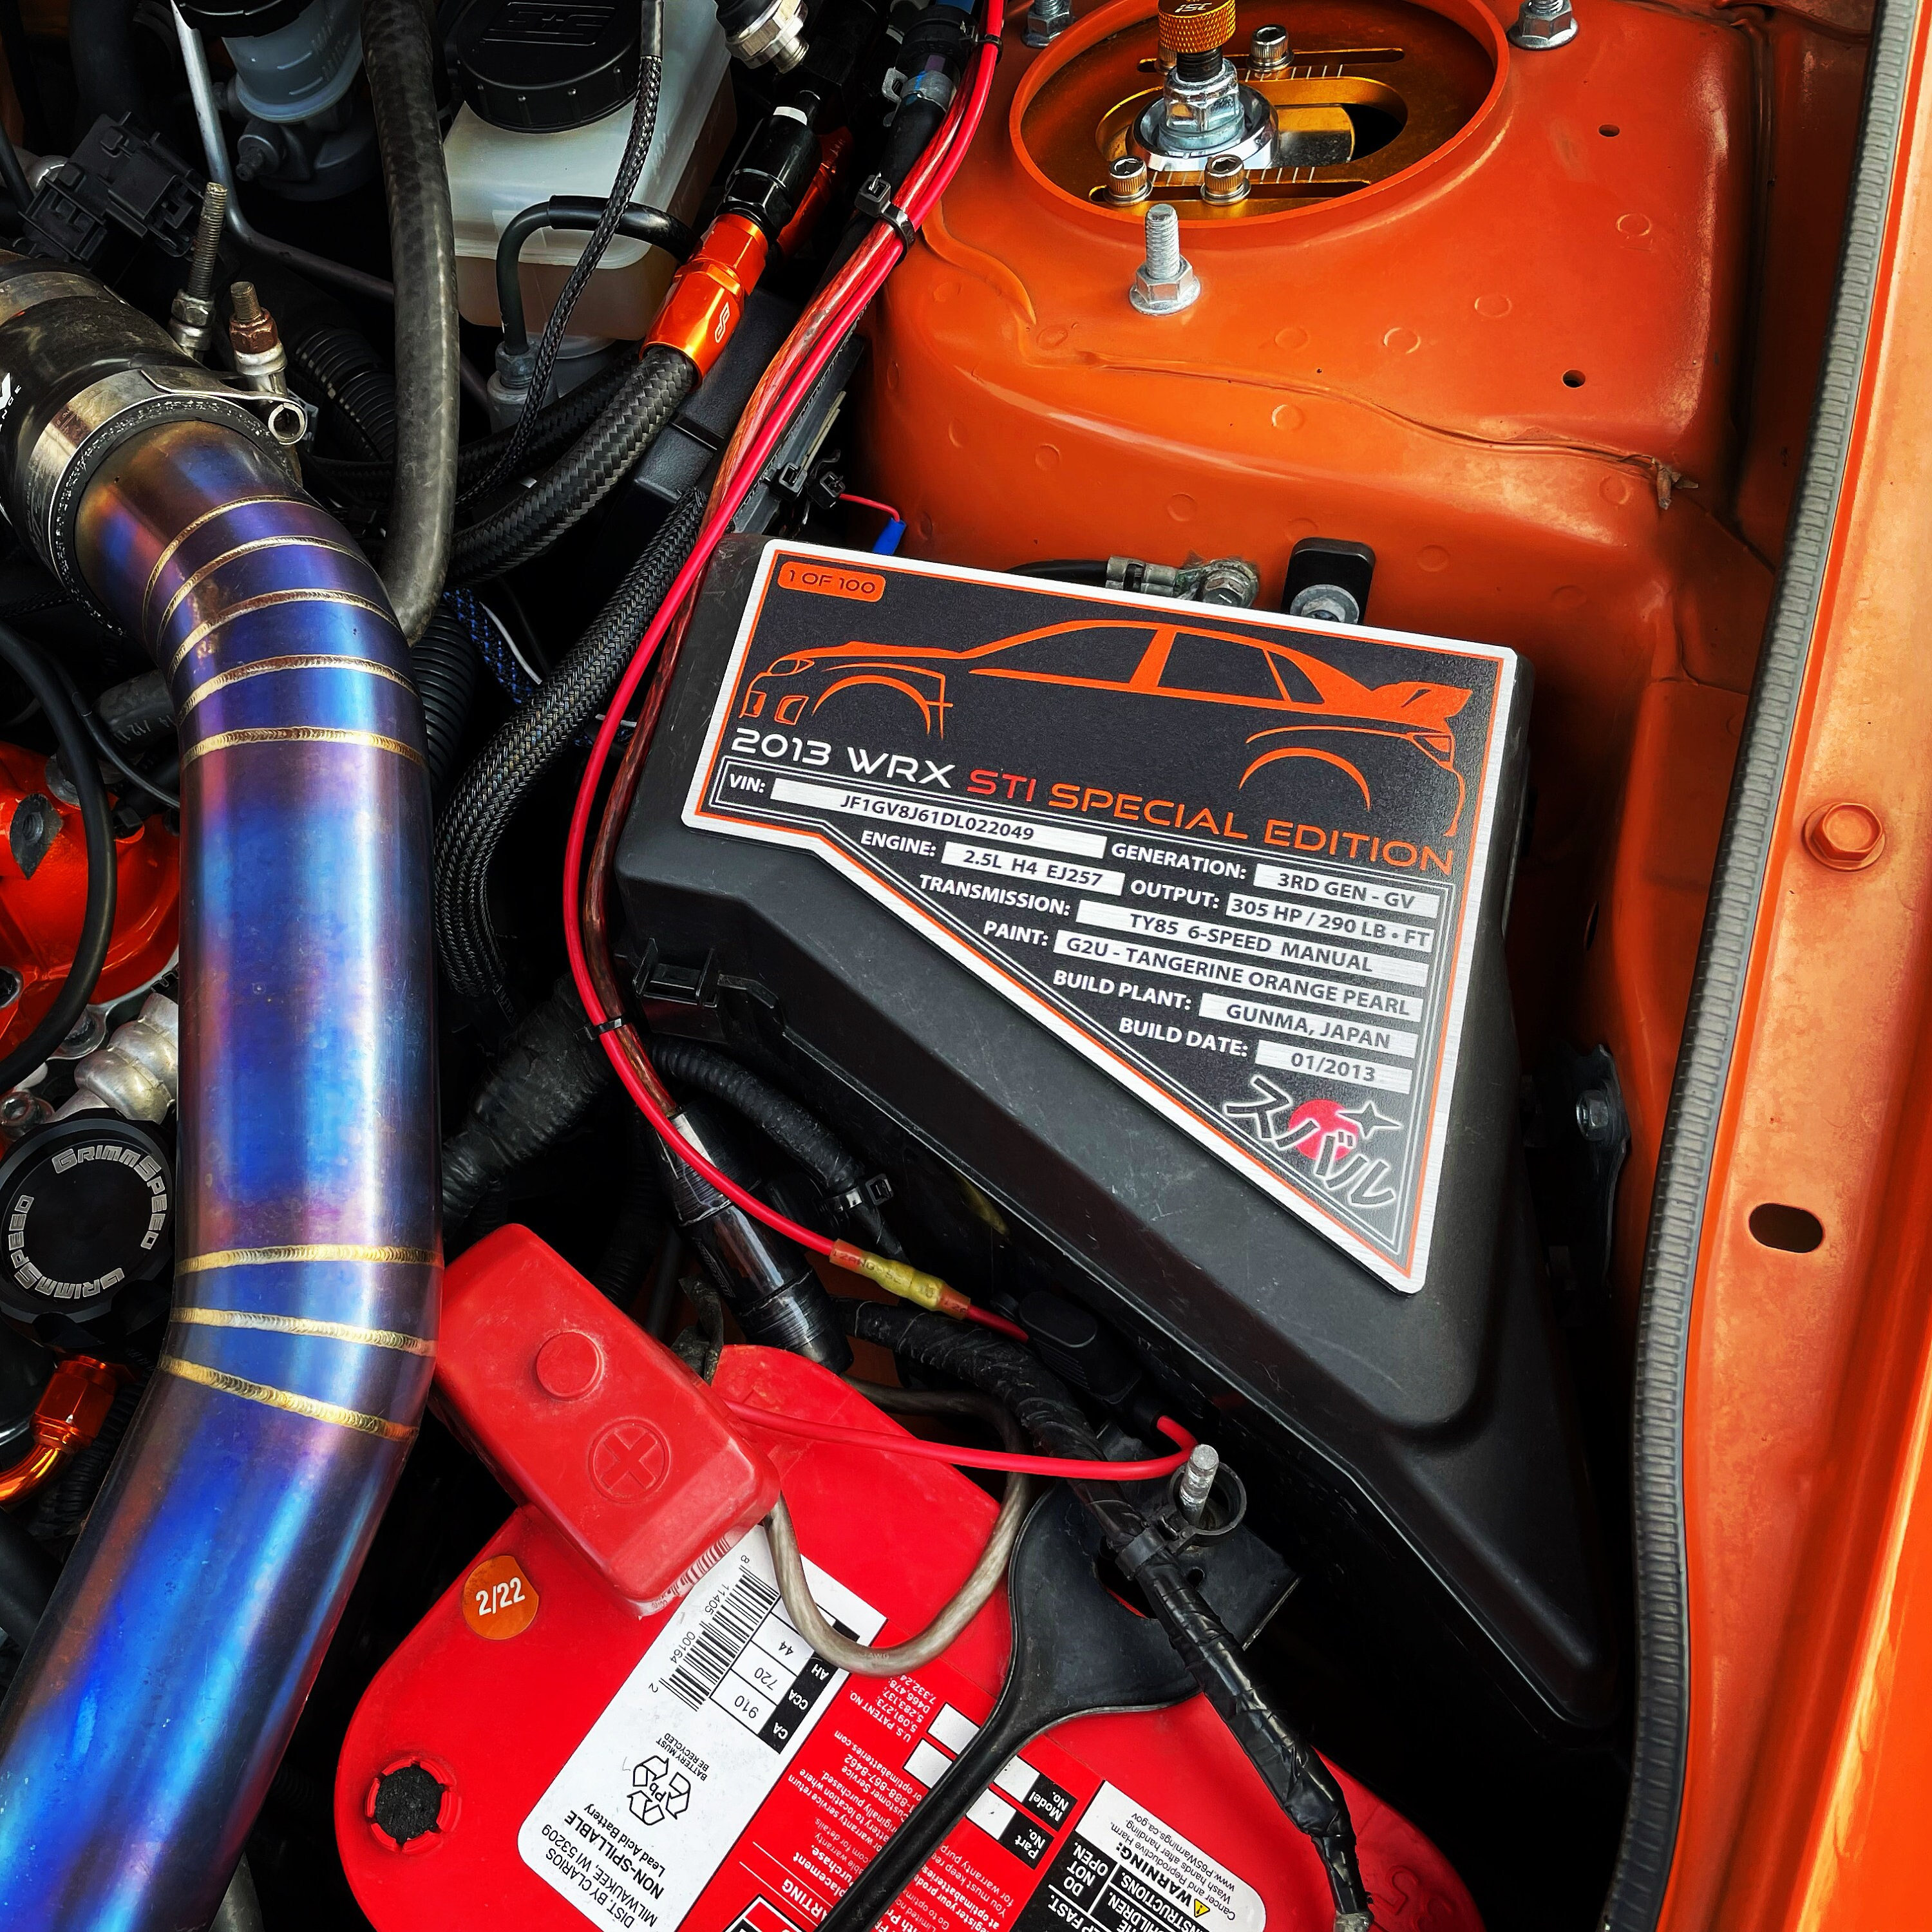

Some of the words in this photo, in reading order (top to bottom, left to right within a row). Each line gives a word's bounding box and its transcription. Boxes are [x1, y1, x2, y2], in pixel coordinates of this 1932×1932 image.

[790, 570, 795, 581] 1
[802, 573, 832, 586] OF
[840, 578, 875, 593] 100
[730, 773, 765, 793] VIN:
[840, 795, 1034, 840] JF1GV8J61DL022049
[732, 728, 831, 765] 2013
[848, 747, 955, 788] WRX
[967, 770, 1036, 801] STI
[1048, 783, 1248, 839] SPECIAL
[1264, 819, 1455, 875] EDITION
[861, 830, 936, 857] ENGINE:
[963, 850, 1001, 868] 2.5L
[1011, 858, 1037, 875] H4
[1046, 865, 1103, 886] EJ257
[1112, 843, 1246, 879] GENERATION:
[1278, 873, 1319, 891] 3RD
[1324, 882, 1367, 901] GEN
[1385, 893, 1416, 909] GV
[916, 875, 1070, 916] TRANSMISSION:
[1130, 914, 1179, 934] TY85
[1188, 926, 1271, 951] 6-SPEED
[1280, 942, 1372, 972] MANUAL
[1131, 880, 1219, 909] OUTPUT:
[1231, 899, 1269, 916] 305
[1274, 905, 1302, 922] HP
[1318, 914, 1356, 933] 290
[1361, 922, 1386, 938] LB
[1404, 929, 1430, 946] FT
[983, 920, 1048, 946] PAINT:
[1067, 938, 1108, 956] G2U
[1126, 948, 1244, 983] TANGERINE
[1249, 972, 1338, 1001] ORANGE
[1343, 989, 1409, 1016] PEARL
[1053, 970, 1115, 994] BUILD
[1118, 983, 1191, 1010] PLANT:
[1223, 1005, 1314, 1038] GUNMA,
[1320, 1023, 1390, 1048] JAPAN
[1119, 1018, 1182, 1043] BUILD
[1186, 1030, 1248, 1057] DATE:
[1291, 1053, 1375, 1081] 01/2013
[52, 1145, 167, 1250] GRIMMSPEED
[8, 1195, 125, 1299] GRIMMSPEED
[741, 1555, 750, 1564] 8
[476, 1577, 526, 1616] 2/22
[705, 1584, 729, 1615] 11405
[670, 1632, 696, 1663] 00164
[779, 1642, 793, 1655] 44
[754, 1668, 777, 1690] 720
[811, 1664, 829, 1680] AH
[649, 1683, 658, 1692] 2
[789, 1689, 808, 1710] CCA
[847, 1688, 864, 1705] NO.
[900, 1671, 936, 1704] 7,332,24
[735, 1696, 759, 1718] 910
[862, 1703, 895, 1730] PATENT
[773, 1723, 788, 1739] CA
[896, 1725, 911, 1743] U.S.
[656, 1738, 677, 1756] MUST
[665, 1733, 699, 1763] RECYCLED
[675, 1754, 707, 1781] BATTERY
[697, 1760, 709, 1772] BE
[835, 1730, 913, 1794] optimabatteries.com
[644, 1779, 668, 1803] Pb
[788, 1775, 812, 1796] return
[800, 1769, 824, 1791] where
[821, 1770, 866, 1807] purchased.
[842, 1766, 871, 1793] Service
[844, 1754, 914, 1813] 1-888-867-8462
[811, 1794, 839, 1817] service
[824, 1788, 856, 1817] location
[870, 1789, 908, 1823] Customer
[913, 1792, 922, 1801] or
[1028, 1792, 1063, 1821] Model
[1053, 1792, 1068, 1811] No.
[584, 1804, 620, 1839] Battery
[813, 1816, 840, 1841] details.
[838, 1814, 873, 1845] warranty
[856, 1814, 864, 1824] to
[542, 1824, 578, 1859] 53209
[618, 1833, 642, 1856] Acid
[840, 1839, 851, 1852] for
[1029, 1829, 1045, 1849] No.
[1111, 1822, 1133, 1845] Harm.
[1123, 1819, 1160, 1852] handling.
[564, 1810, 664, 1899] NON-SPILLABLE
[1015, 1835, 1039, 1859] Part
[1073, 1842, 1108, 1876] OPEN.
[1132, 1814, 1235, 1891] www.P65Warnings.ca.gov
[1160, 1848, 1180, 1864] after
[546, 1848, 592, 1891] CLARIOS
[576, 1853, 592, 1872] WI
[639, 1852, 665, 1877] Lead
[945, 1864, 966, 1885] keep
[1066, 1861, 1095, 1886] NOT
[1116, 1842, 1191, 1907] WARNING:
[1135, 1842, 1187, 1885] Reproductive
[1181, 1862, 1206, 1886] hands
[961, 1861, 999, 1895] warranty
[966, 1880, 987, 1900] must
[1064, 1877, 1084, 1897] DO
[1187, 1881, 1204, 1896] and
[589, 1888, 608, 1905] BY
[593, 1865, 658, 1927] MILWAUKEE,
[922, 1864, 989, 1921] optimabatteries
[936, 1893, 958, 1911] your
[1000, 1893, 1014, 1907] for
[1121, 1873, 1202, 1932] NSTRUCTIONS.
[1208, 1882, 1230, 1904] Wash
[607, 1900, 634, 1928] DIST.
[929, 1910, 937, 1920] to
[990, 1899, 1006, 1918] You
[1048, 1895, 1084, 1929] FAST.
[1108, 1892, 1164, 1932] HILDREN.
[1205, 1895, 1235, 1920] Cancer
[938, 1917, 949, 1929] Go
[989, 1918, 999, 1929] at
